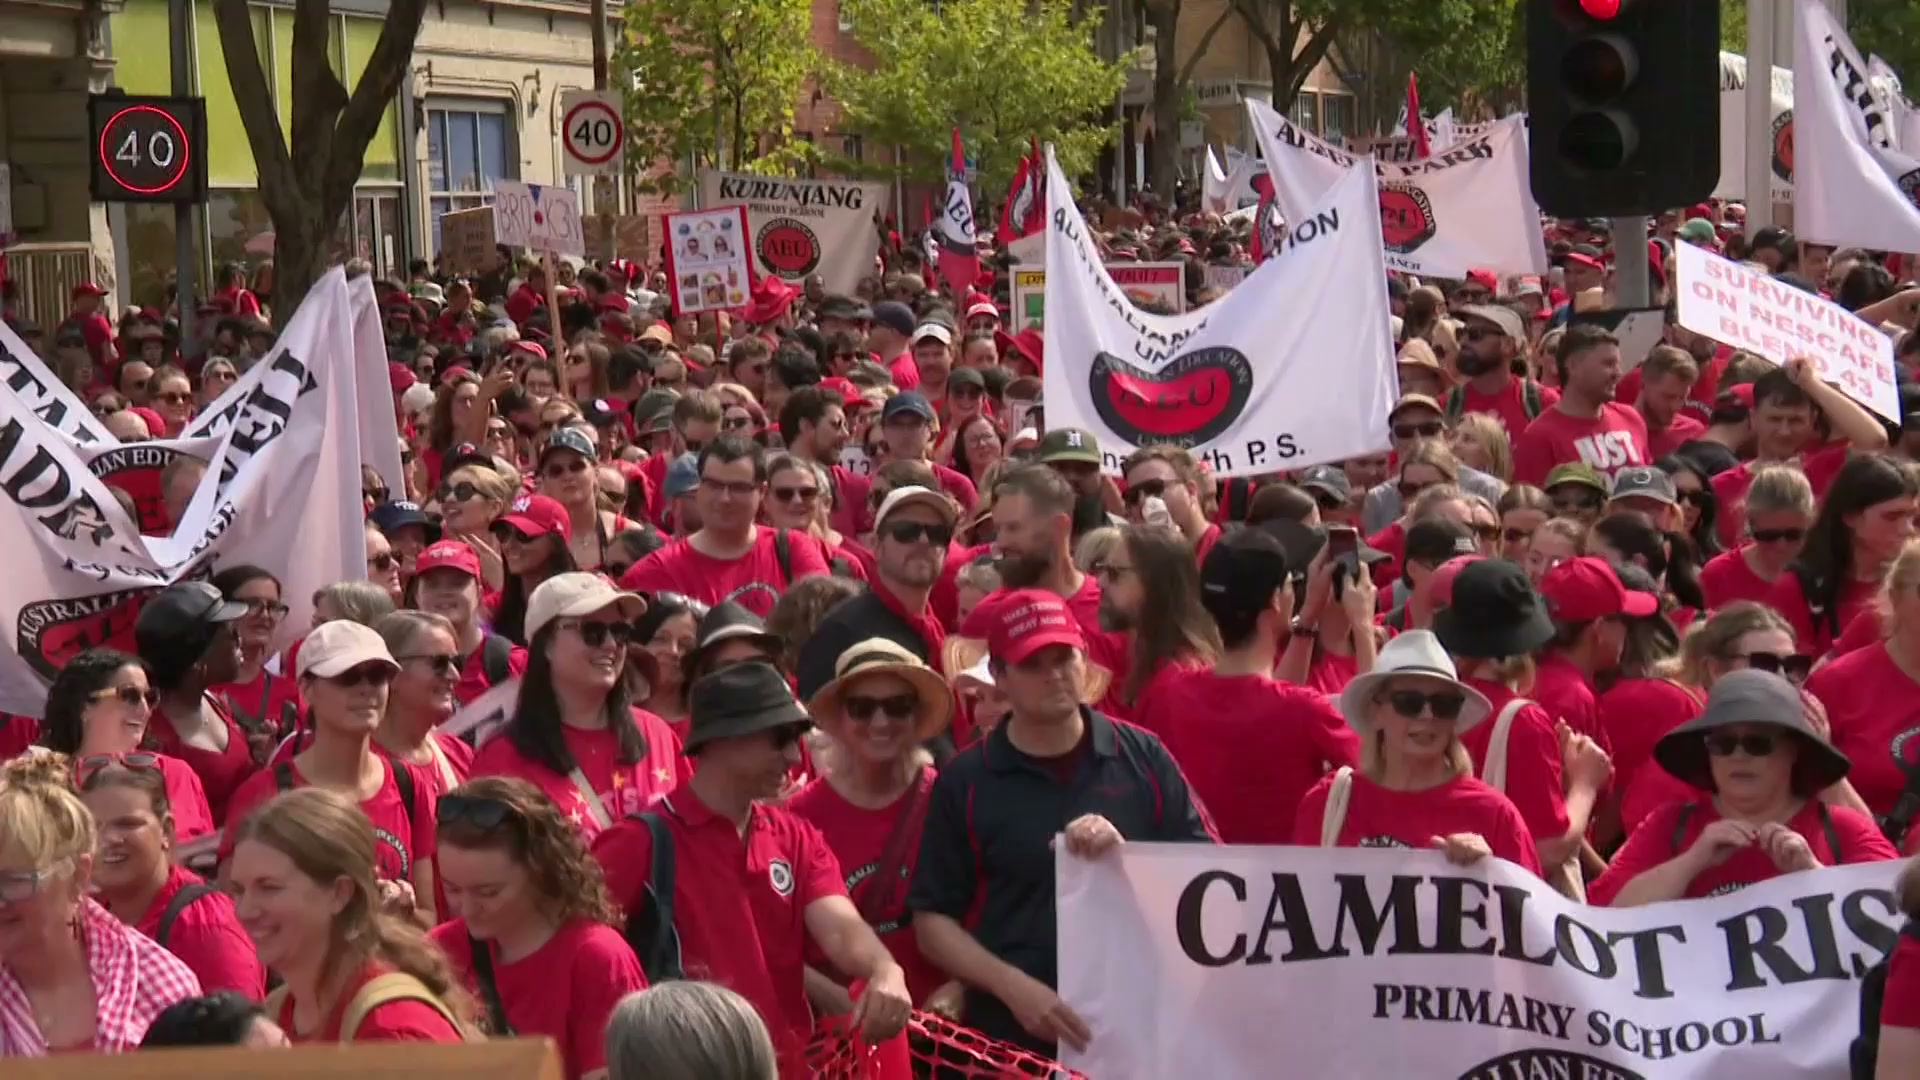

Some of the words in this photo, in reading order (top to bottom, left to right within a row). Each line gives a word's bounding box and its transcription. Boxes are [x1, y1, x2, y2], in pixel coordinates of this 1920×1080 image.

[115, 130, 175, 168] 40
[573, 118, 612, 147] 40
[719, 176, 864, 210] KURUNJANG
[1691, 280, 1738, 313] ON
[1749, 302, 1893, 386] NESCAFE
[1703, 258, 1880, 351] SURVIVING
[1839, 367, 1874, 399] 43
[1175, 868, 1687, 999] CAMELOT
[1373, 982, 1576, 1041] PRIMARY
[1586, 1008, 1782, 1060] SCHOOL
